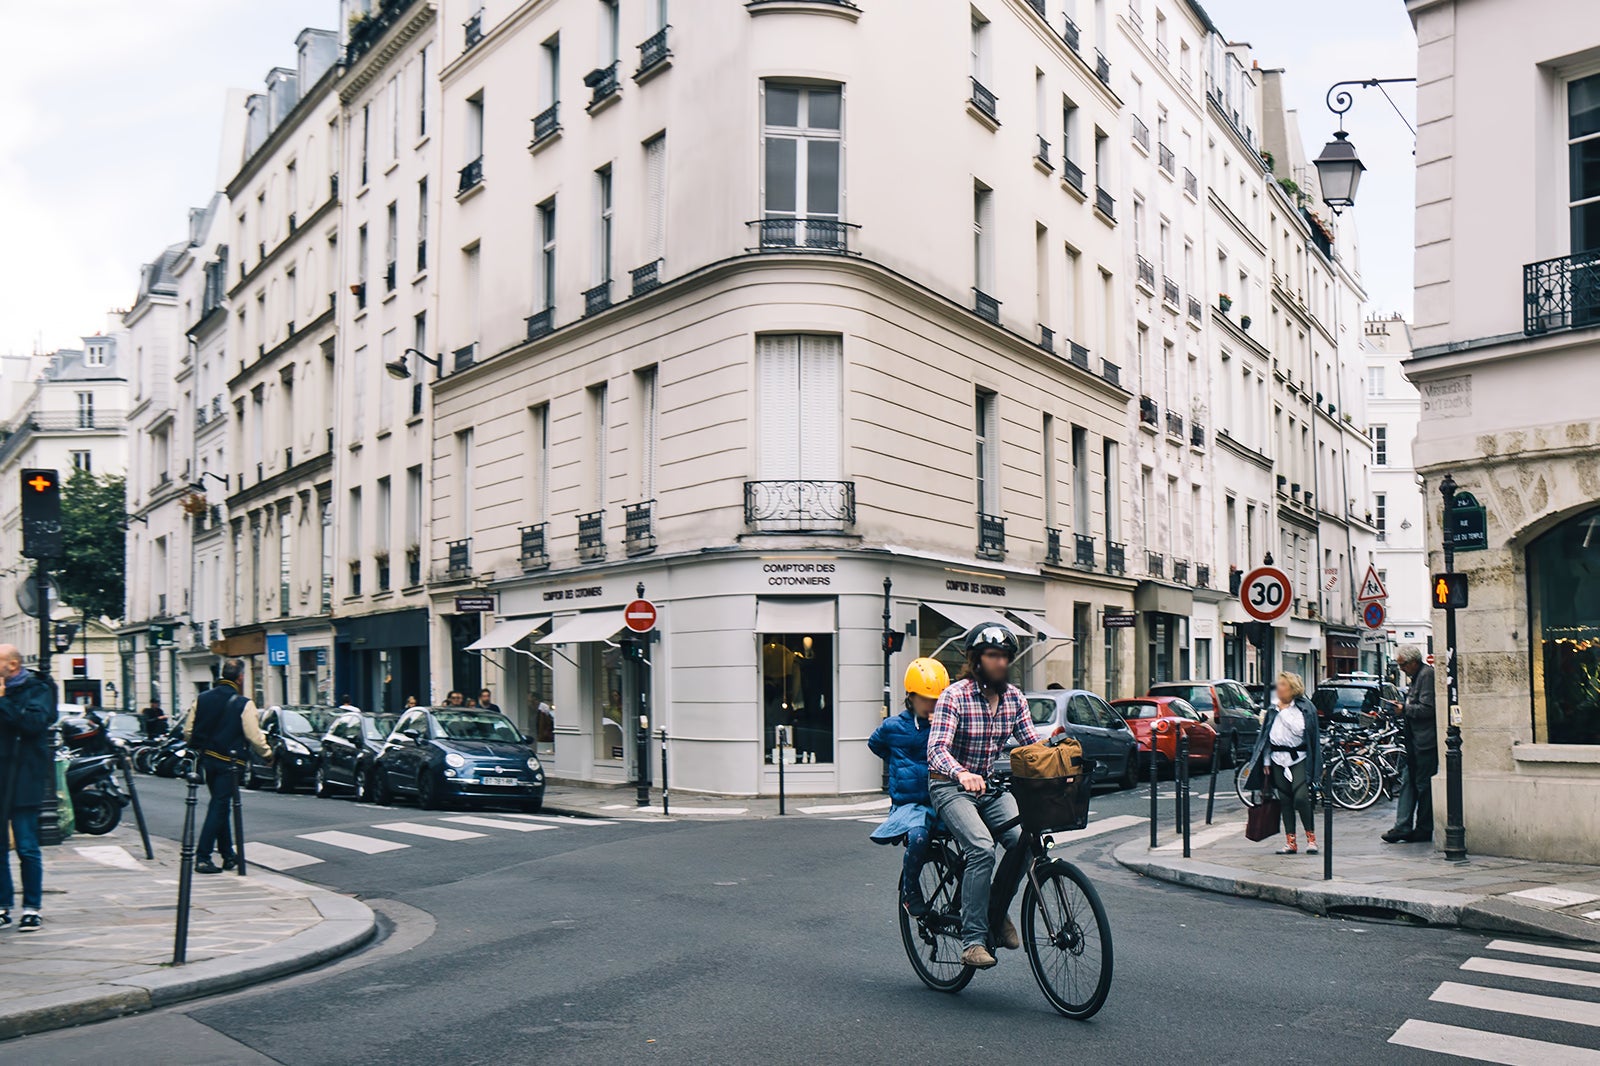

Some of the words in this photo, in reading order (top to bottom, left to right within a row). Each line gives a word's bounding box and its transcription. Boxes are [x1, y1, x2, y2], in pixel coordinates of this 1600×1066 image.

[1468, 531, 1484, 540] TEMPLE
[763, 563, 815, 573] COMPTOIR
[816, 563, 836, 573] DES
[768, 576, 831, 586] COTONNIERS
[1325, 576, 1338, 592] CLUB
[1251, 582, 1283, 606] 30
[271, 648, 286, 662] ie
